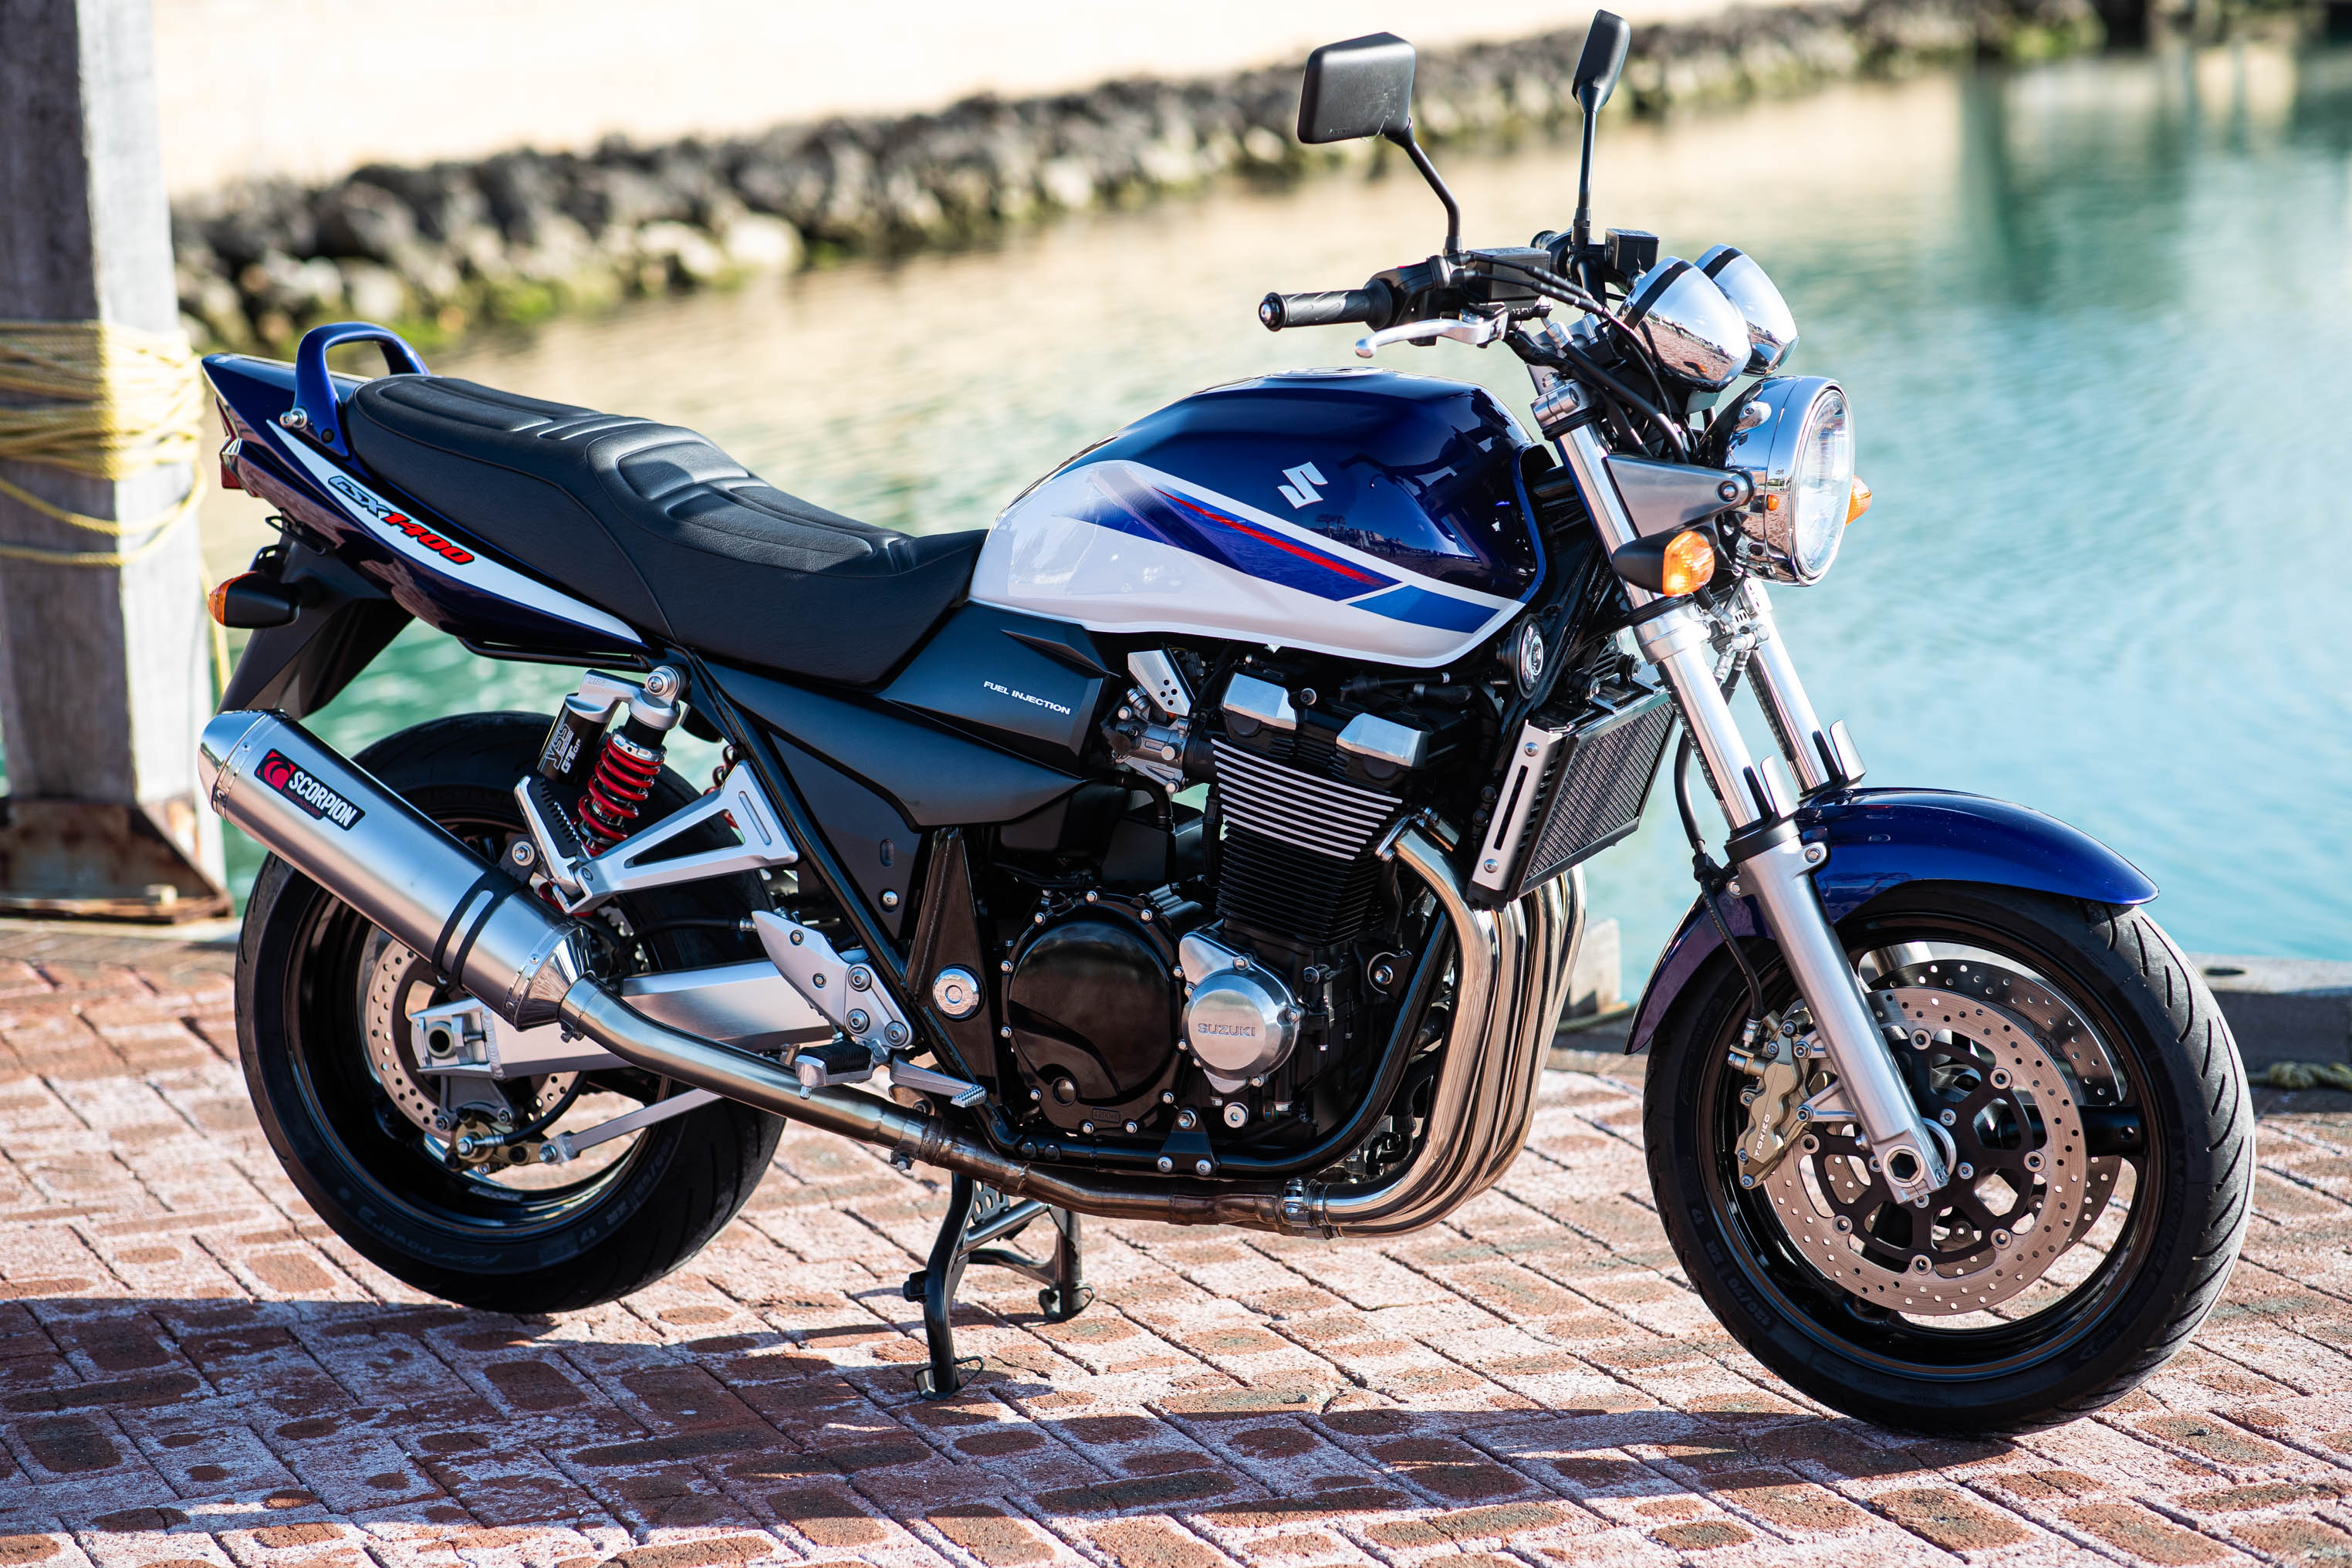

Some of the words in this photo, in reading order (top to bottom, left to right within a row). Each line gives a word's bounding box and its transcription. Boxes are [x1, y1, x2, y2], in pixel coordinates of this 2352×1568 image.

[983, 681, 1009, 694] FUEL
[1012, 690, 1070, 715] INJECTION
[288, 771, 357, 826] SCORPION
[1198, 1022, 1255, 1036] SUZUKI
[1754, 1113, 1770, 1155] TOKICO
[1728, 1277, 1770, 1326] 120/70
